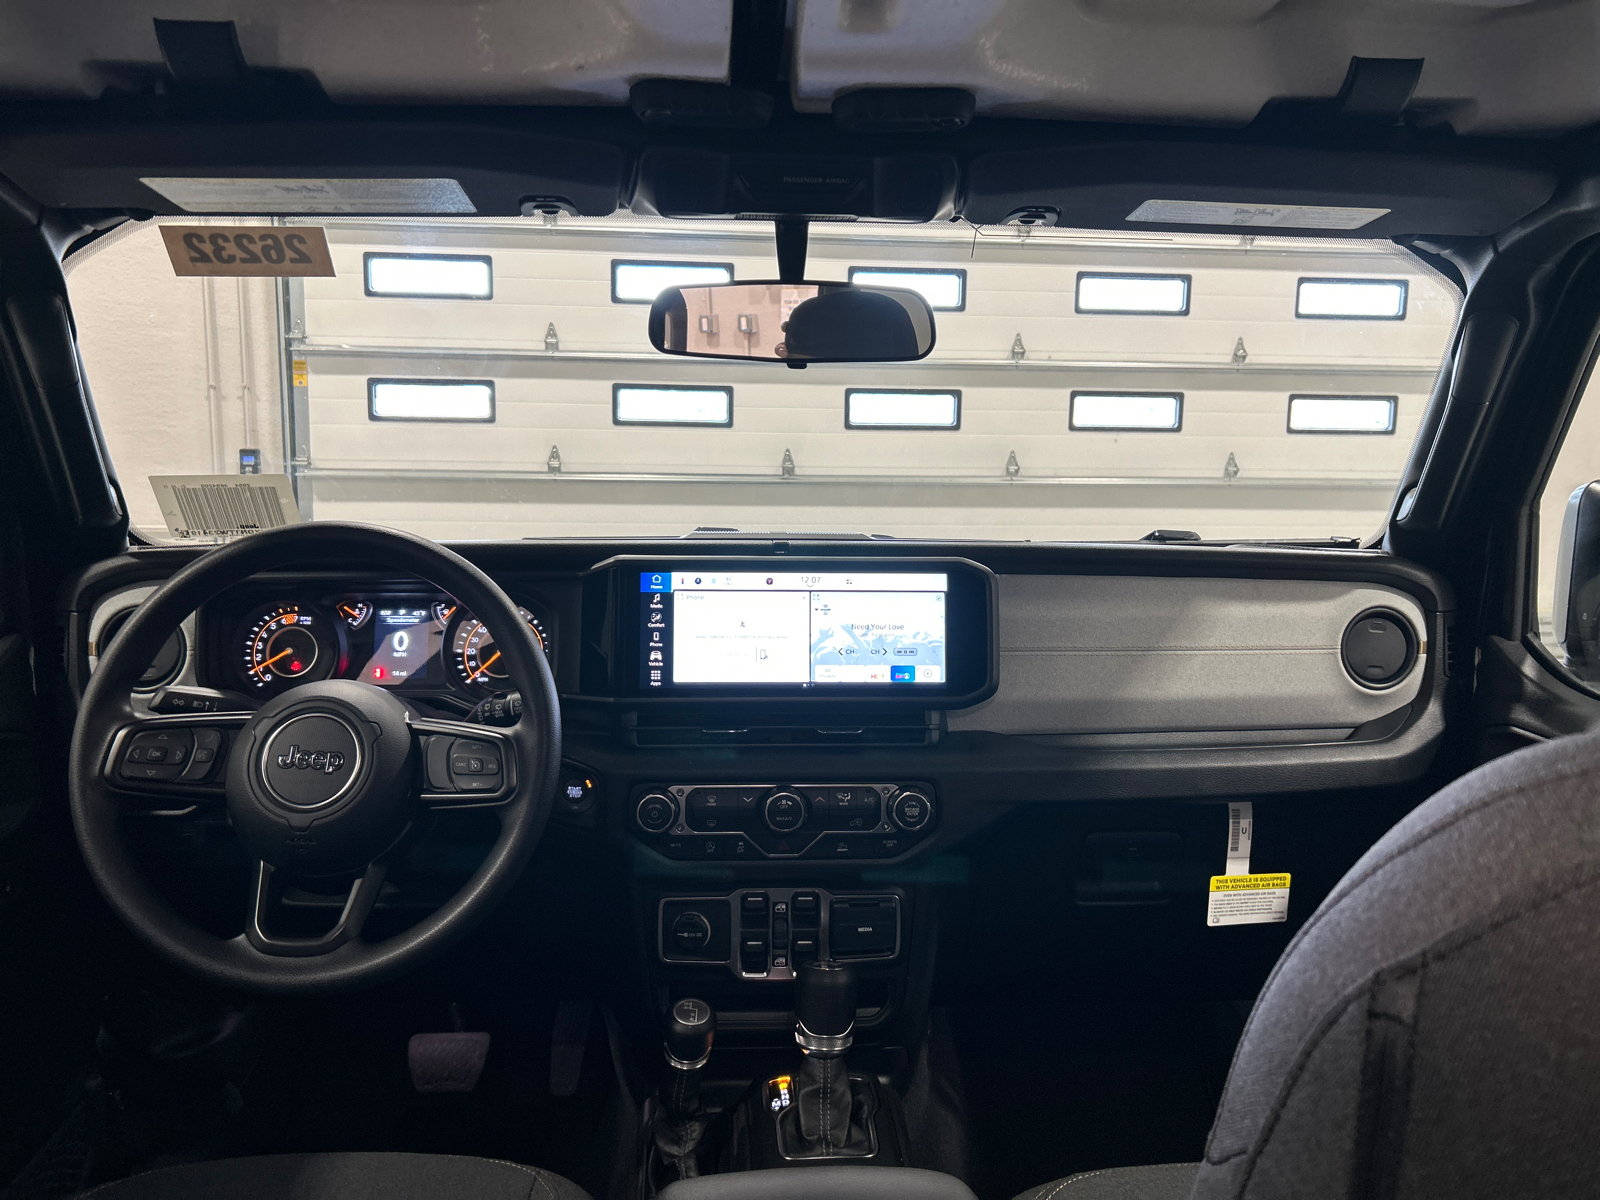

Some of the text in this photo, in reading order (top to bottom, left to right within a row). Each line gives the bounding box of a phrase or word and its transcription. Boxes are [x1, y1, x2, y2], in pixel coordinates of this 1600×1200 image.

[801, 576, 821, 584] 1207
[294, 615, 298, 623] 7
[257, 641, 263, 649] 3
[393, 631, 408, 651] 0
[277, 745, 345, 775] Jeep
